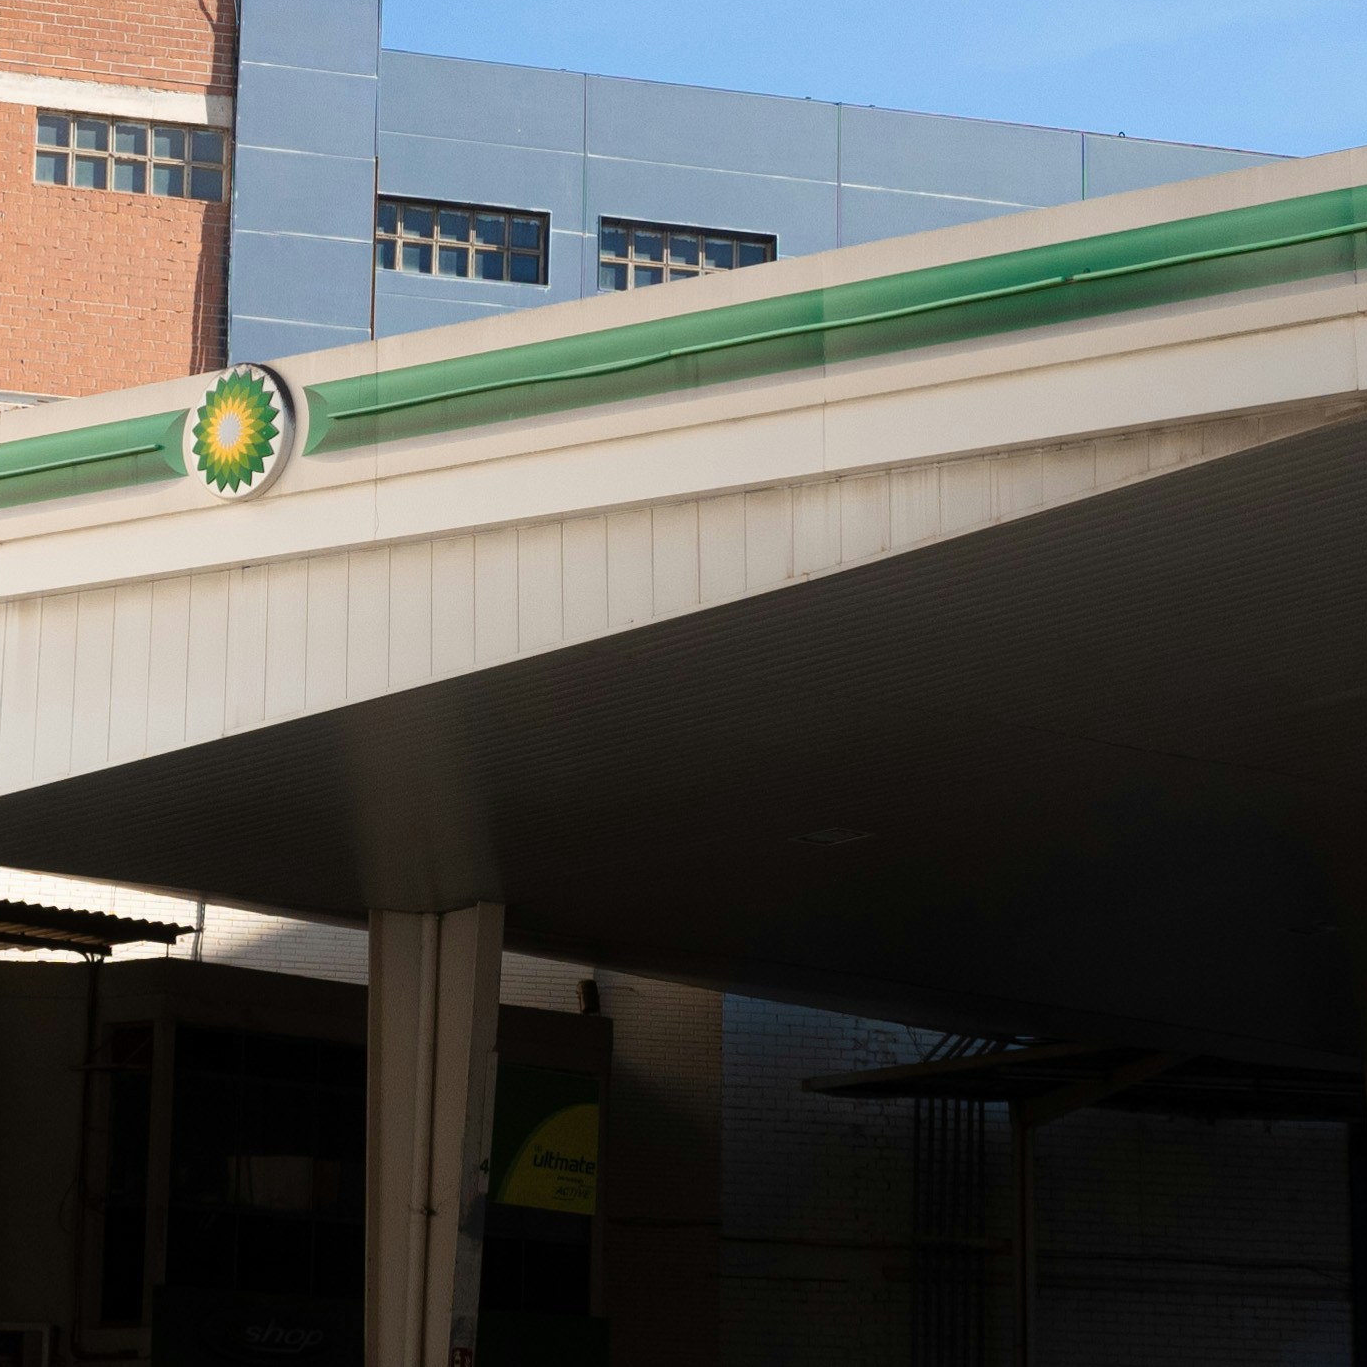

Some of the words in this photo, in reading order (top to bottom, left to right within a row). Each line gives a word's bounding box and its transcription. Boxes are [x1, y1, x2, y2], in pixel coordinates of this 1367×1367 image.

[480, 1159, 489, 1174] 4
[533, 1151, 596, 1174] ultimate
[245, 1317, 324, 1353] shop
